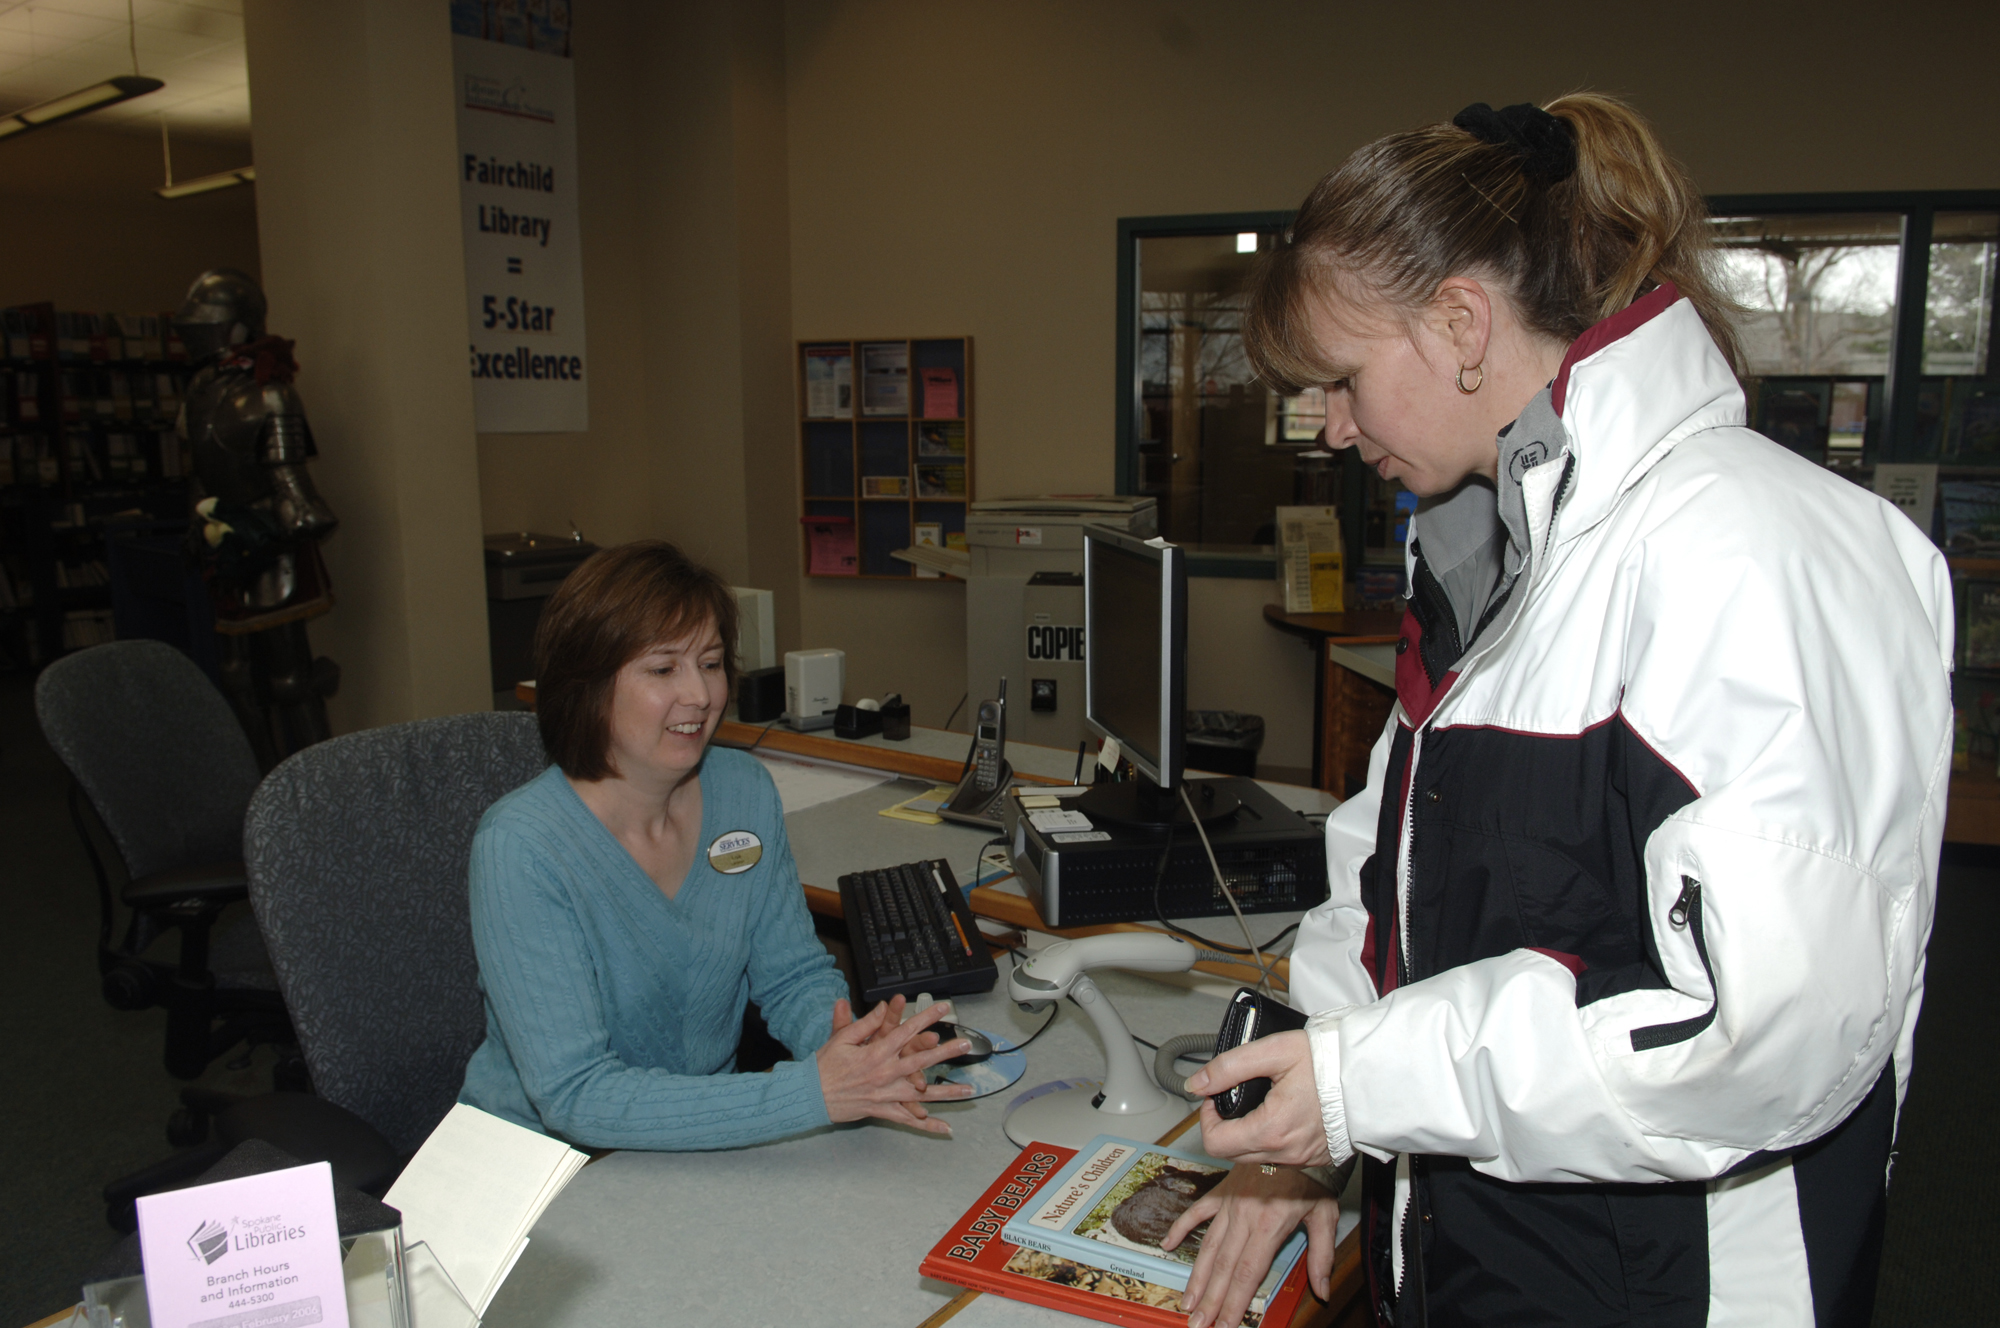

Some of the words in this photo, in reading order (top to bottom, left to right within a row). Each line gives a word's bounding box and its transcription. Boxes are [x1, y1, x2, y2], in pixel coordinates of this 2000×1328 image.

[464, 154, 554, 192] Fairchild
[479, 205, 551, 246] Library
[483, 295, 554, 331] 5-Star
[1042, 1182, 1090, 1223] Nature's
[1081, 1148, 1126, 1182] Children
[946, 1207, 1008, 1262] BABY
[992, 1152, 1059, 1210] BEARS
[242, 1214, 281, 1228] Spokane
[254, 1223, 282, 1234] Public
[235, 1225, 306, 1251] Libraries
[1003, 1233, 1027, 1246] BLACK
[1028, 1239, 1052, 1252] BEARS
[207, 1269, 249, 1286] Branch
[253, 1262, 290, 1276] Hours
[1109, 1263, 1145, 1279] Greenland
[200, 1288, 224, 1303] and
[228, 1275, 299, 1296] Information
[228, 1292, 275, 1308] 444-5300
[241, 1311, 289, 1328] February
[292, 1305, 319, 1319] 2006
